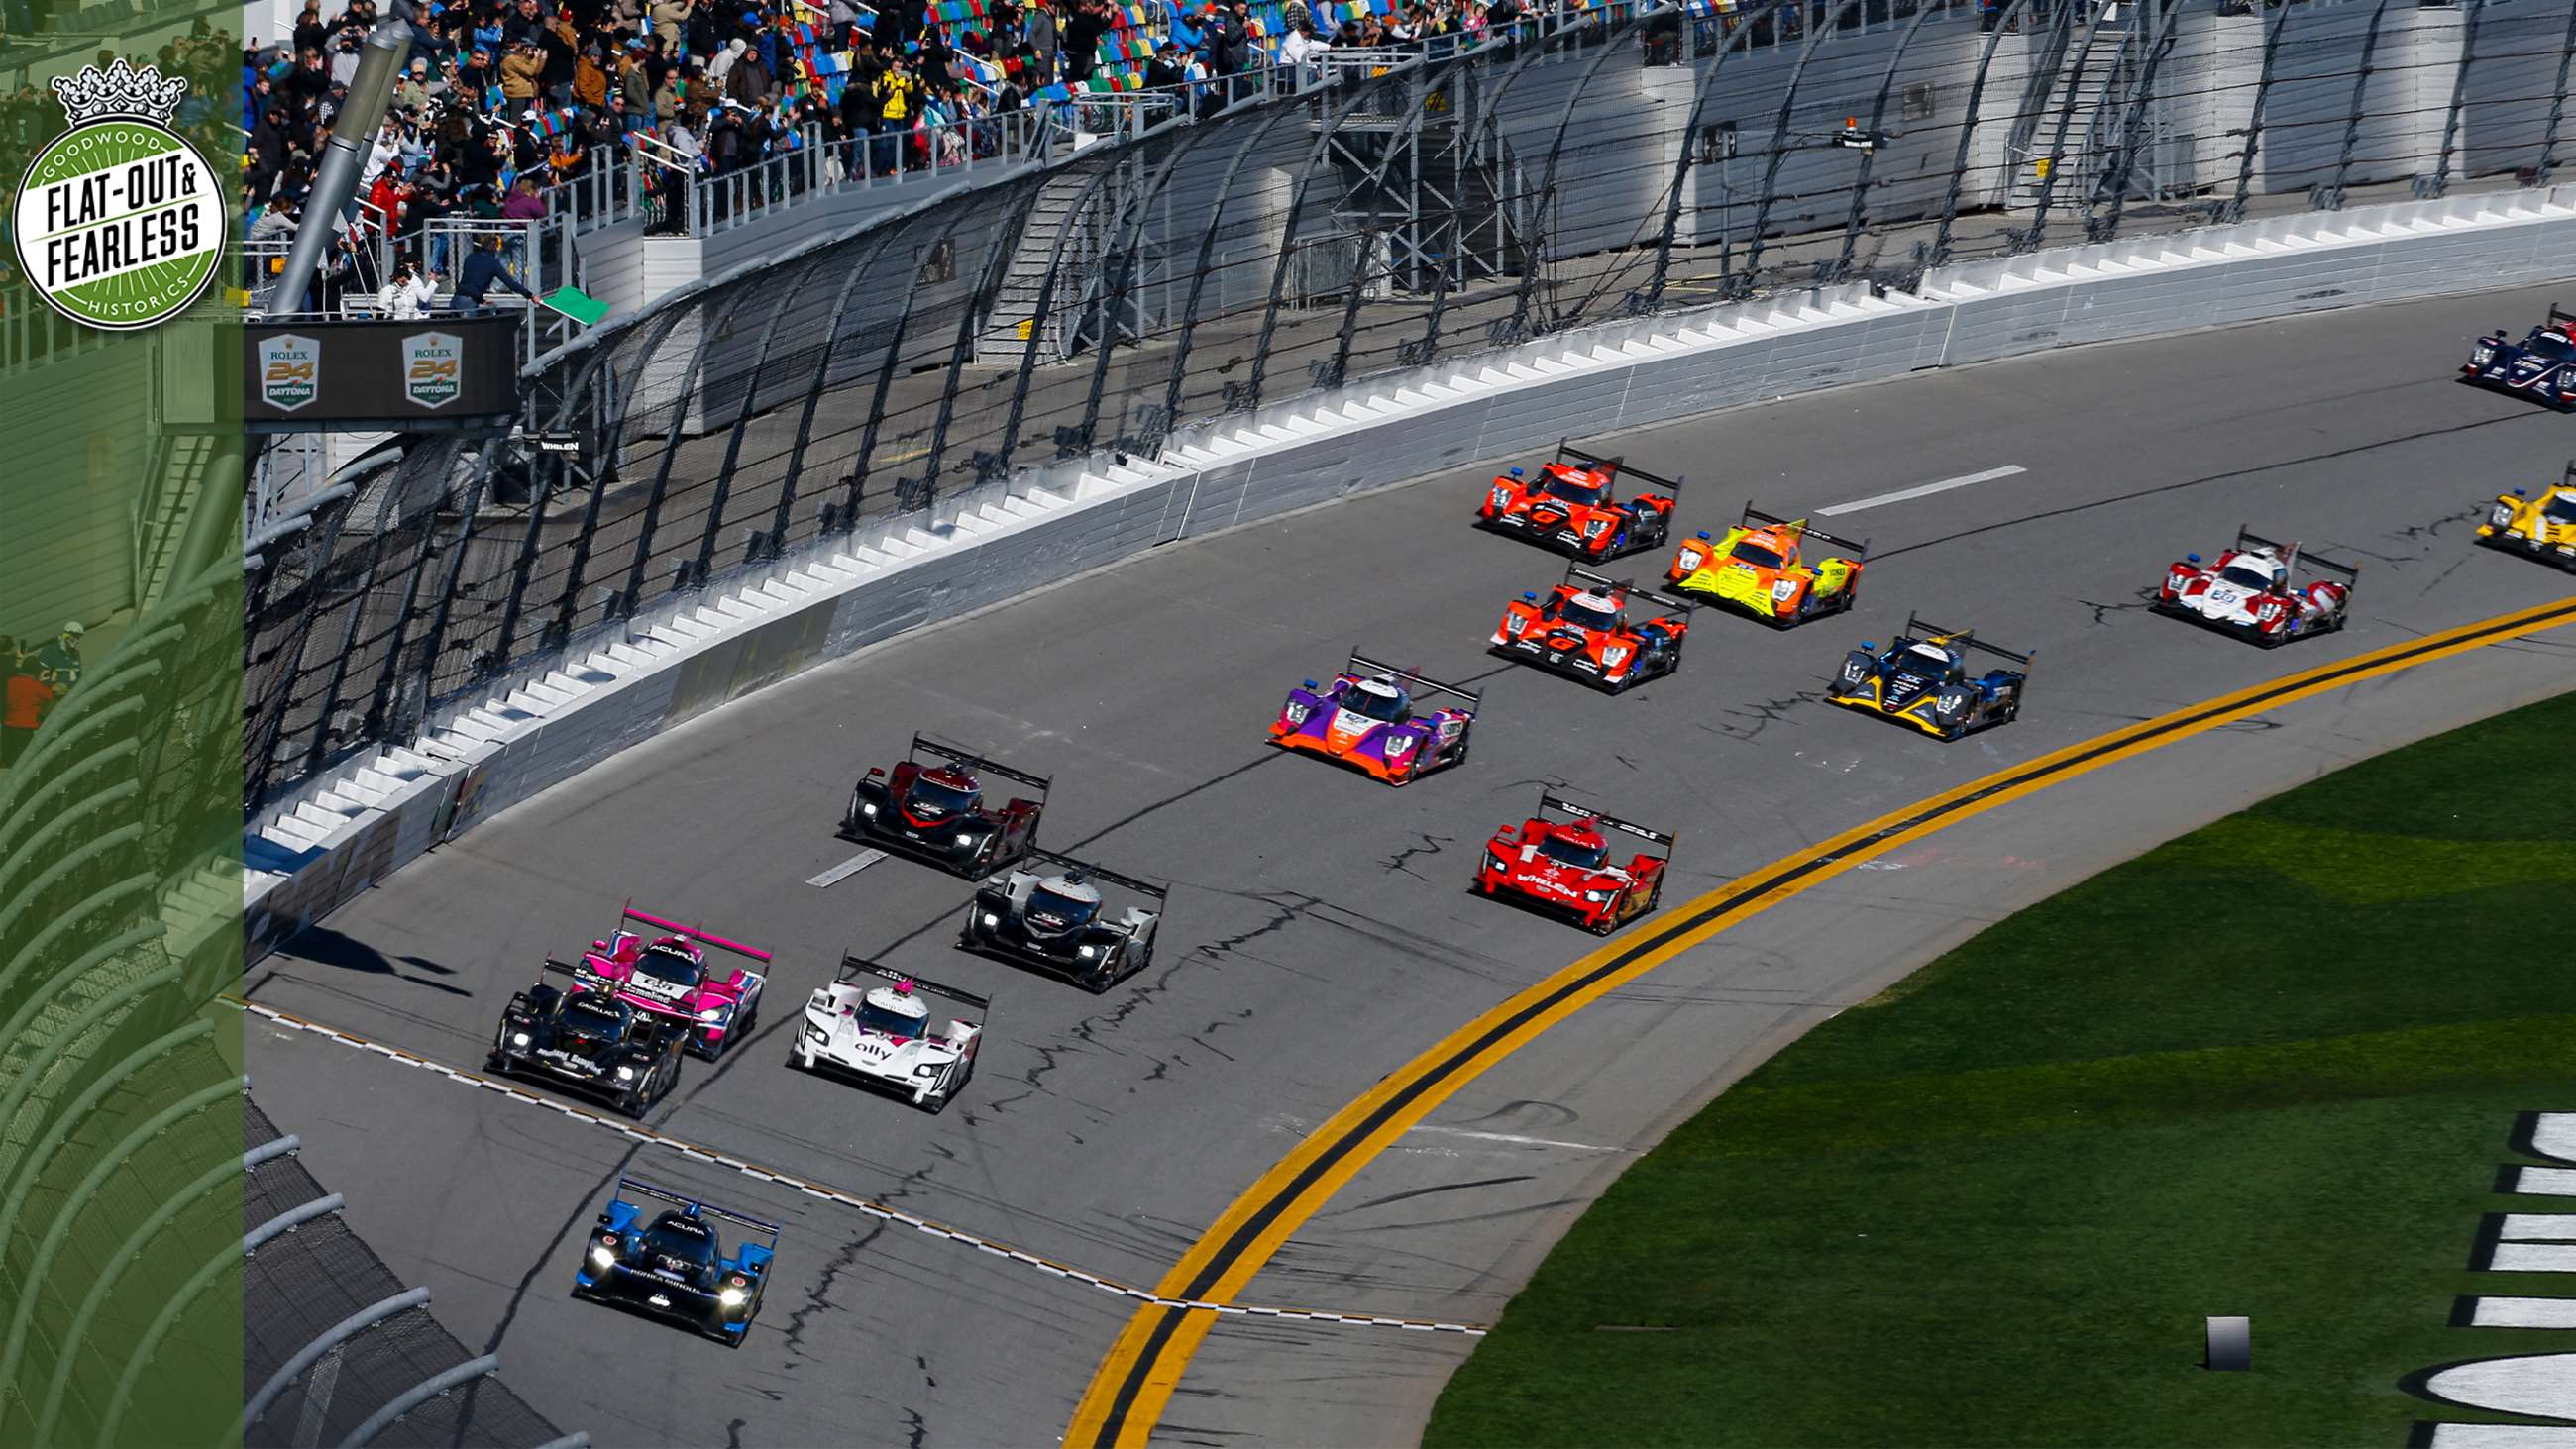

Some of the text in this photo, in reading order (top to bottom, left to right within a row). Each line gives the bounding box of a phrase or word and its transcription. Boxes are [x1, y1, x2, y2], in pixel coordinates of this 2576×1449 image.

[269, 351, 308, 360] ROLEX
[414, 349, 452, 358] ROLEX
[266, 362, 314, 380] 24
[409, 359, 459, 378] 24
[268, 387, 311, 396] DAYTONA
[412, 384, 455, 394] DAYTONA
[1517, 873, 1578, 898] WHELEN
[650, 945, 697, 965] ACURA
[578, 1001, 621, 1018] CADILLAC
[855, 1043, 892, 1061] ally
[666, 1220, 705, 1236] ACURA
